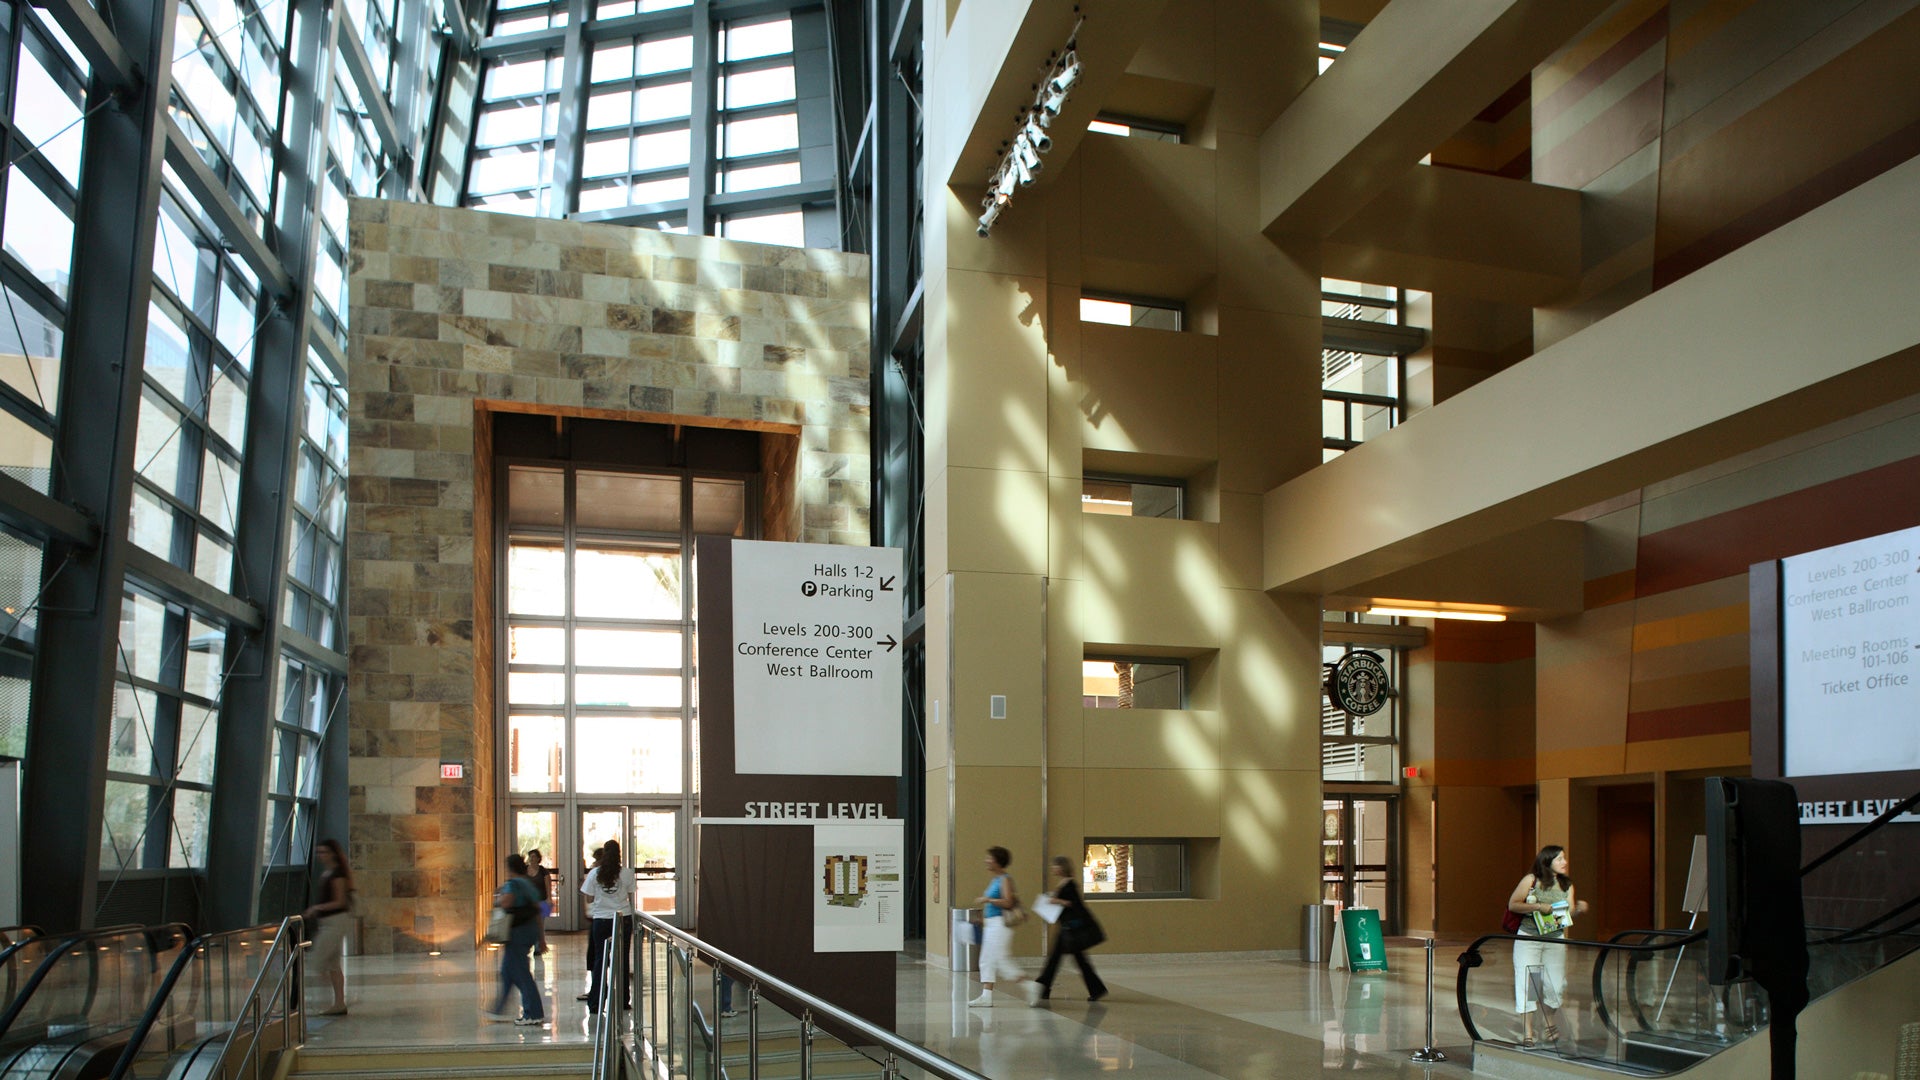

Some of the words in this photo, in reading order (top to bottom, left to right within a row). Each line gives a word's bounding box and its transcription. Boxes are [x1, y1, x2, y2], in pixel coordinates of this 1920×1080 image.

[814, 563, 847, 578] Halls
[854, 565, 874, 579] 1-2
[1808, 564, 1847, 583] Levels
[1852, 549, 1910, 574] 200-300
[820, 584, 874, 602] Parking
[1787, 584, 1858, 607] Conference
[1863, 574, 1909, 592] Center
[1811, 607, 1843, 622] West
[1849, 595, 1909, 616] Ballroom
[763, 622, 807, 637] Levels
[814, 624, 873, 639] 200-300
[738, 642, 819, 658] Conference
[826, 645, 873, 660] Center
[1802, 645, 1857, 663] Meeting
[1862, 637, 1909, 654] Rooms
[1862, 650, 1909, 669] 101-106
[767, 663, 803, 678] West
[810, 665, 873, 679] Ballroom
[1340, 660, 1386, 685] STARBUCKS
[1821, 679, 1860, 695] Ticket
[1866, 673, 1909, 690] Office
[1345, 697, 1380, 712] COFFEE
[744, 801, 820, 819] STREET
[827, 802, 888, 819] LEVEL
